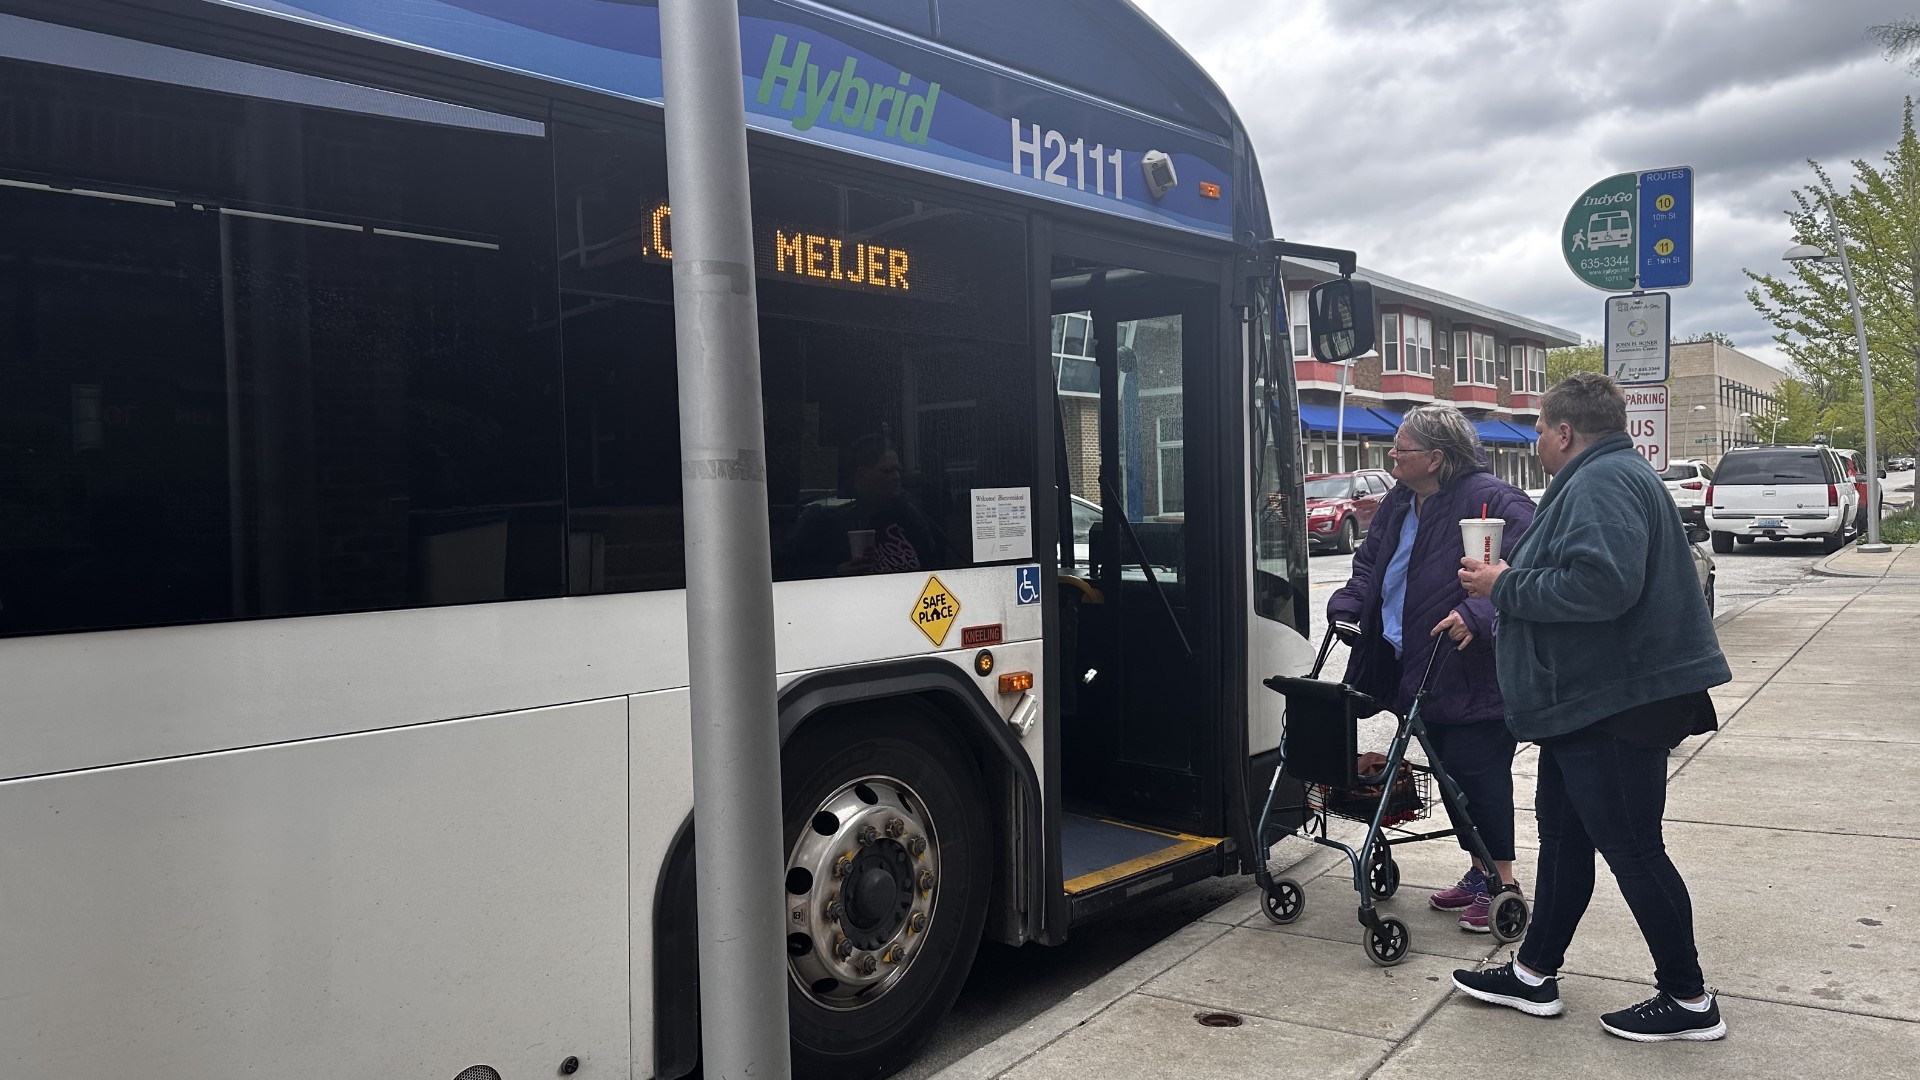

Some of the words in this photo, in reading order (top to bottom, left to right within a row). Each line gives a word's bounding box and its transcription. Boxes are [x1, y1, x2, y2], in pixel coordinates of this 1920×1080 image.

[756, 34, 941, 146] Hybrid
[1011, 117, 1123, 200] H2111
[1646, 170, 1684, 182] ROUTES
[1583, 192, 1633, 206] IndyGo
[1658, 197, 1671, 209] 10
[1652, 213, 1667, 221] 10th
[1659, 242, 1669, 253] 11
[776, 229, 909, 290] MEIJER
[1581, 255, 1630, 270] 635-3344
[1625, 392, 1665, 406] PARKING
[1630, 419, 1655, 438] US
[1635, 444, 1660, 462] OP
[922, 593, 947, 610] SAFE
[965, 628, 1000, 644] KNEELING
